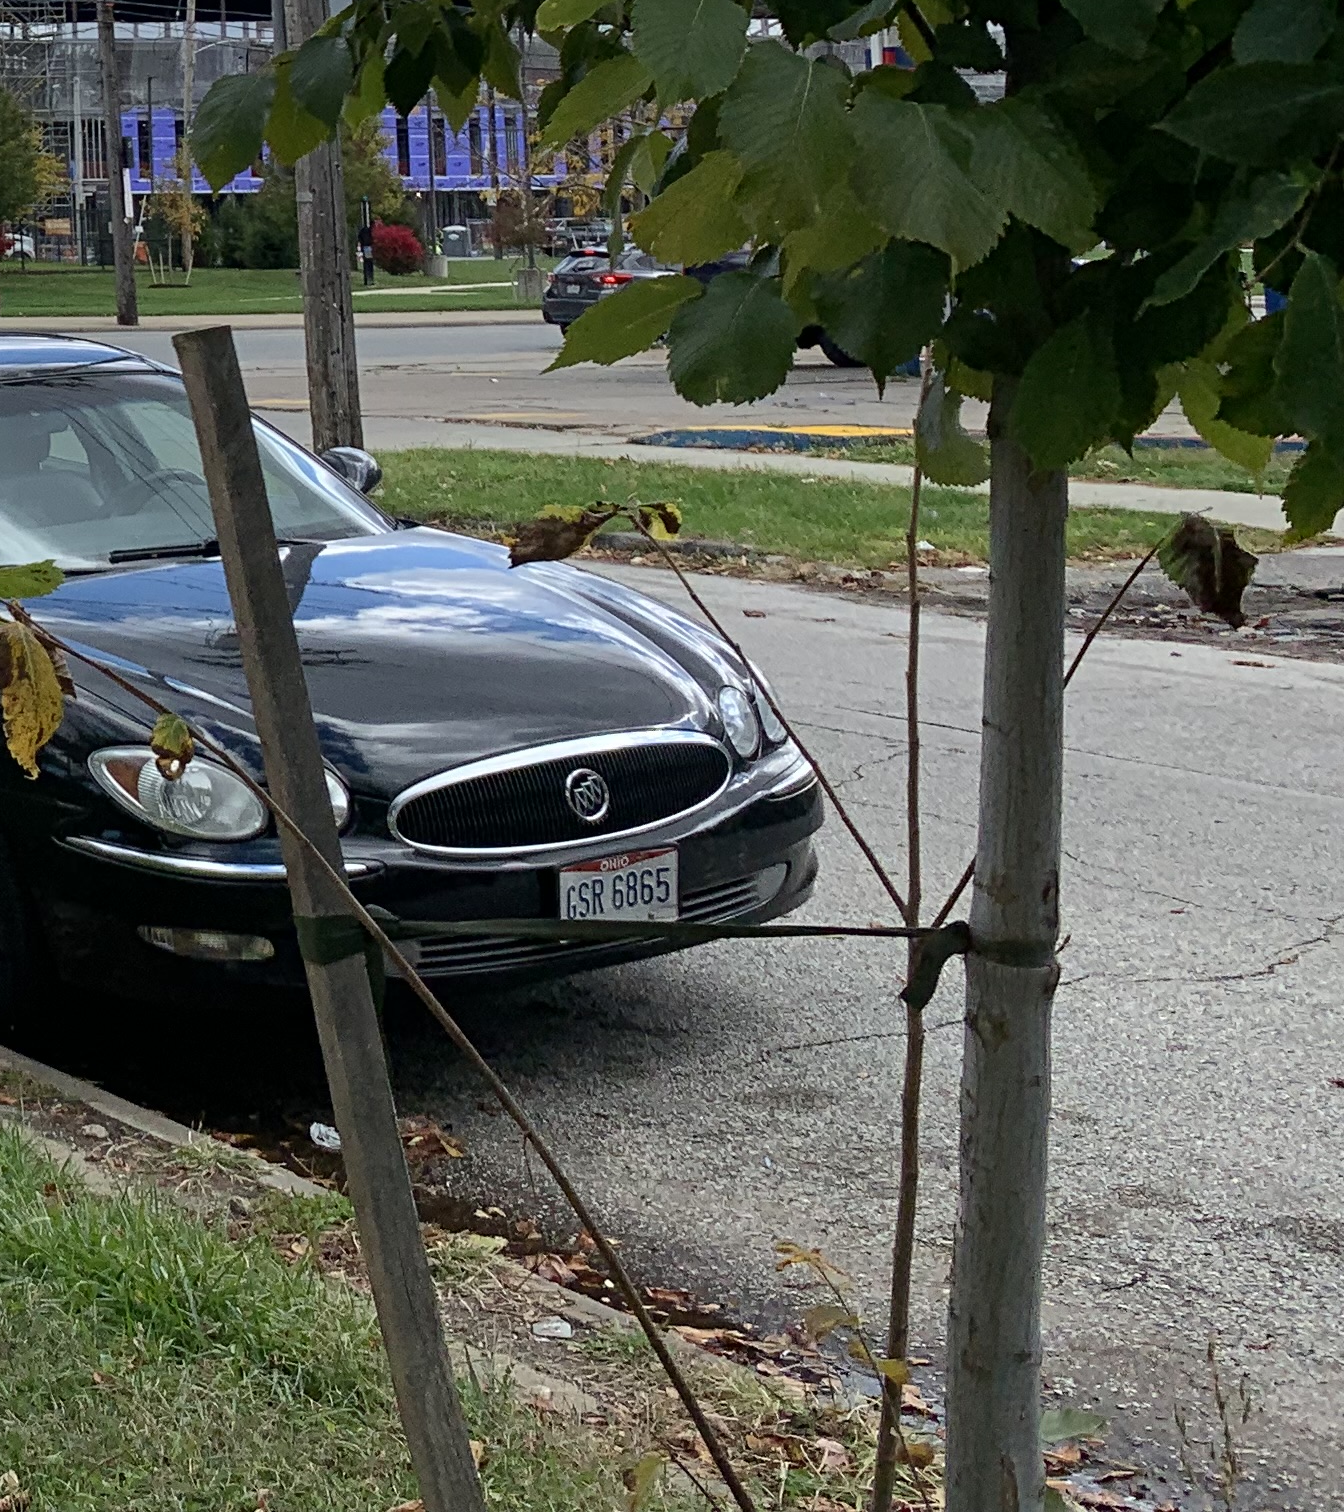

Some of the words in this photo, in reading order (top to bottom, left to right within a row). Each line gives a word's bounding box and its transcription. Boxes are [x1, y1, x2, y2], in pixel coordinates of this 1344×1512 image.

[599, 855, 630, 872] OHIO
[566, 878, 605, 920] GSR
[613, 867, 670, 910] 6865
